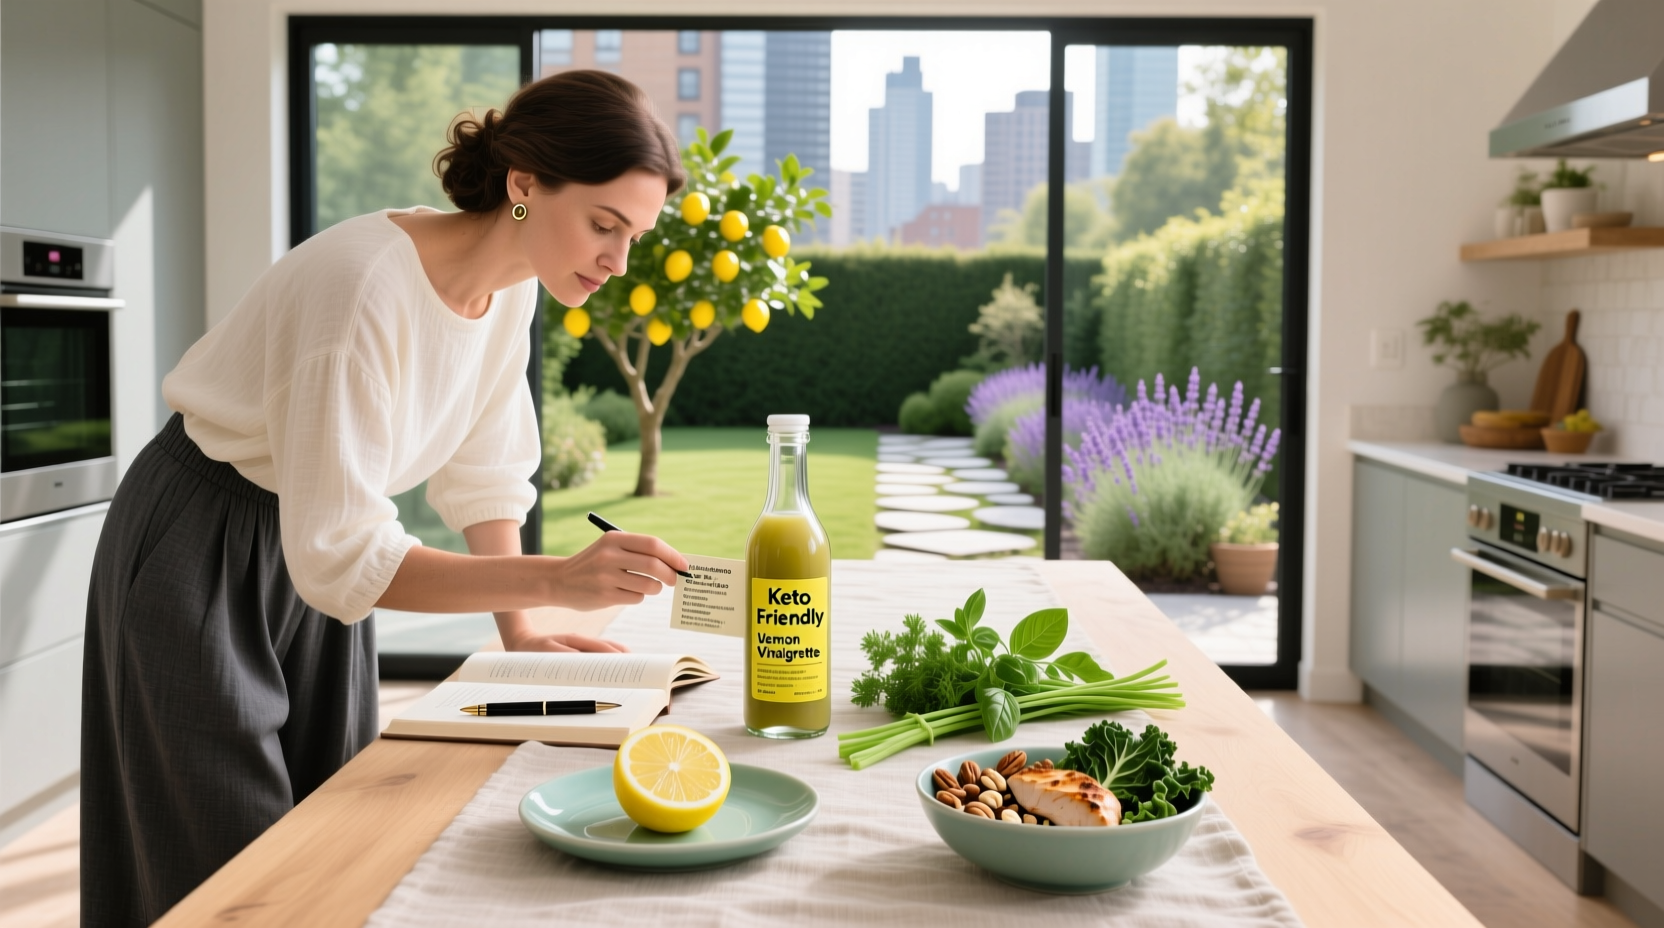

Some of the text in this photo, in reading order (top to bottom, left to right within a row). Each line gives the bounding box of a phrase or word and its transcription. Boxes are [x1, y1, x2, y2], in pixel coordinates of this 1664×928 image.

[768, 587, 811, 605] Keto
[757, 607, 824, 628] Friendly
[757, 632, 800, 645] Vemon
